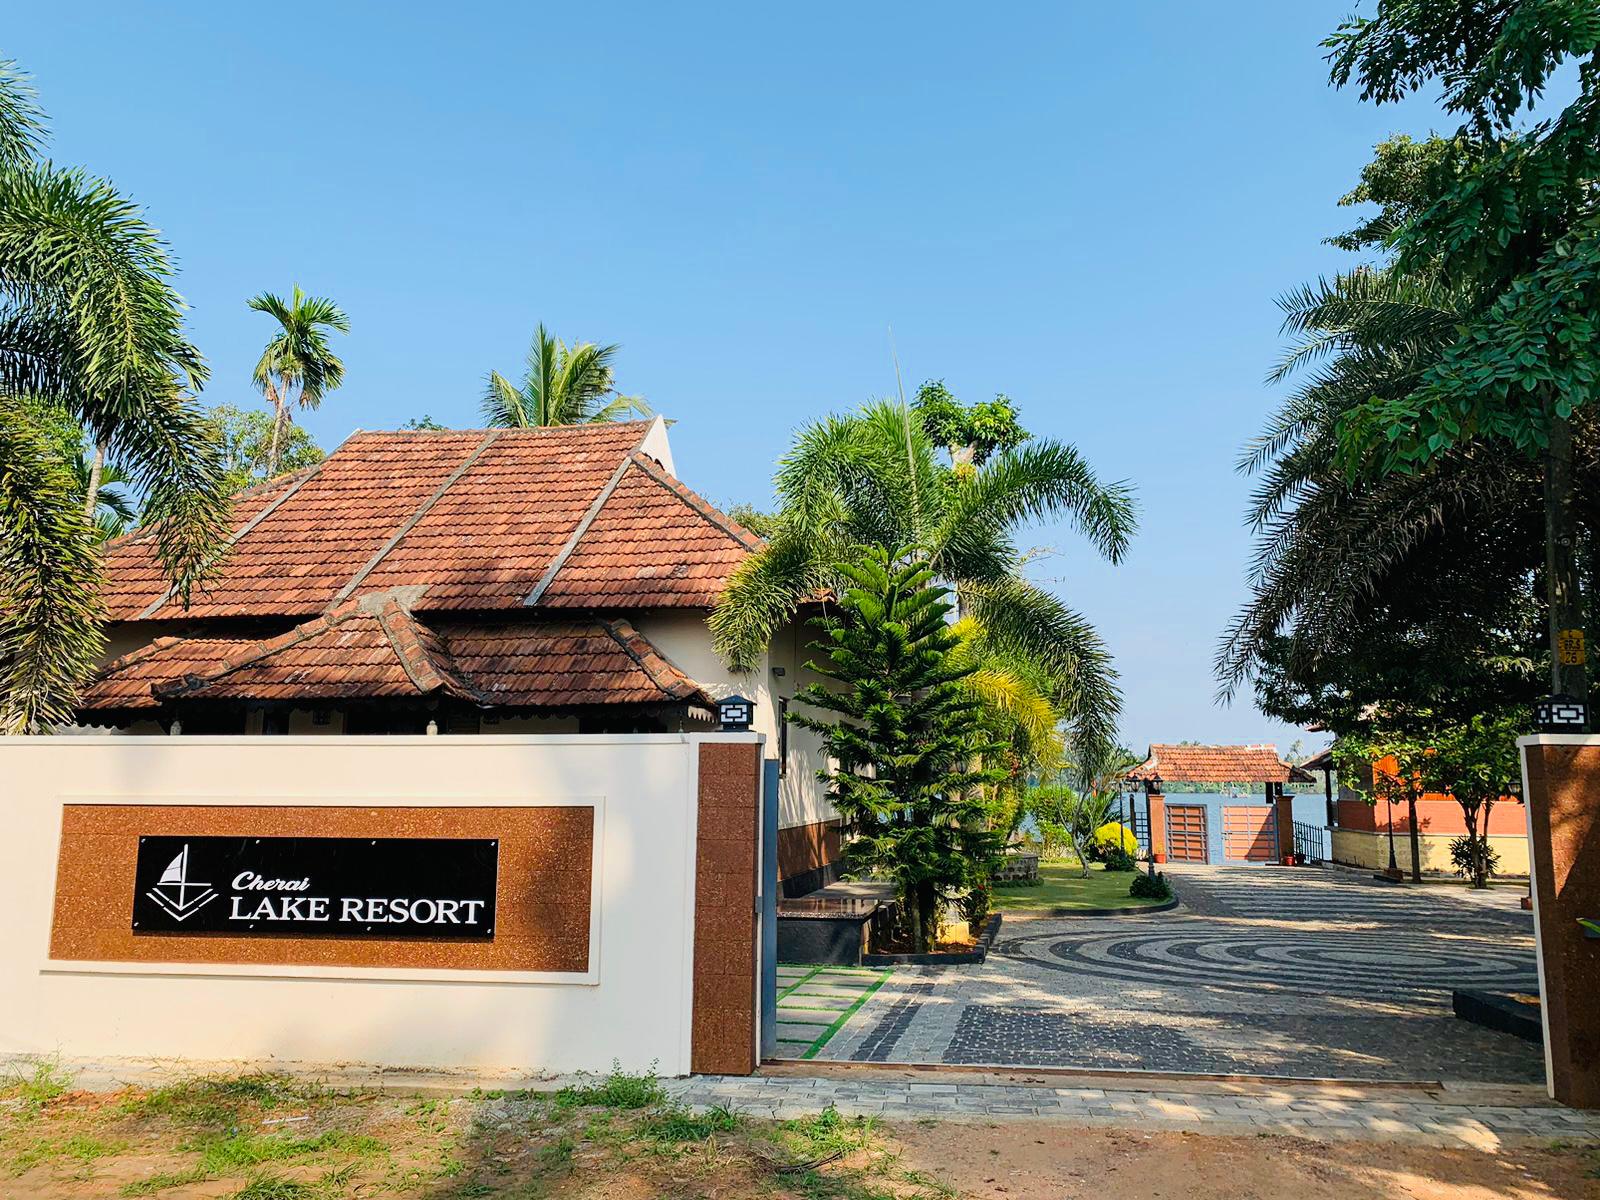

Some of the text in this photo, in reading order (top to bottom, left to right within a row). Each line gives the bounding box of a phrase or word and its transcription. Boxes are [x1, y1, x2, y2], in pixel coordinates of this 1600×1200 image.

[231, 870, 311, 892] Cherai
[228, 896, 485, 925] LAKE RESORT
